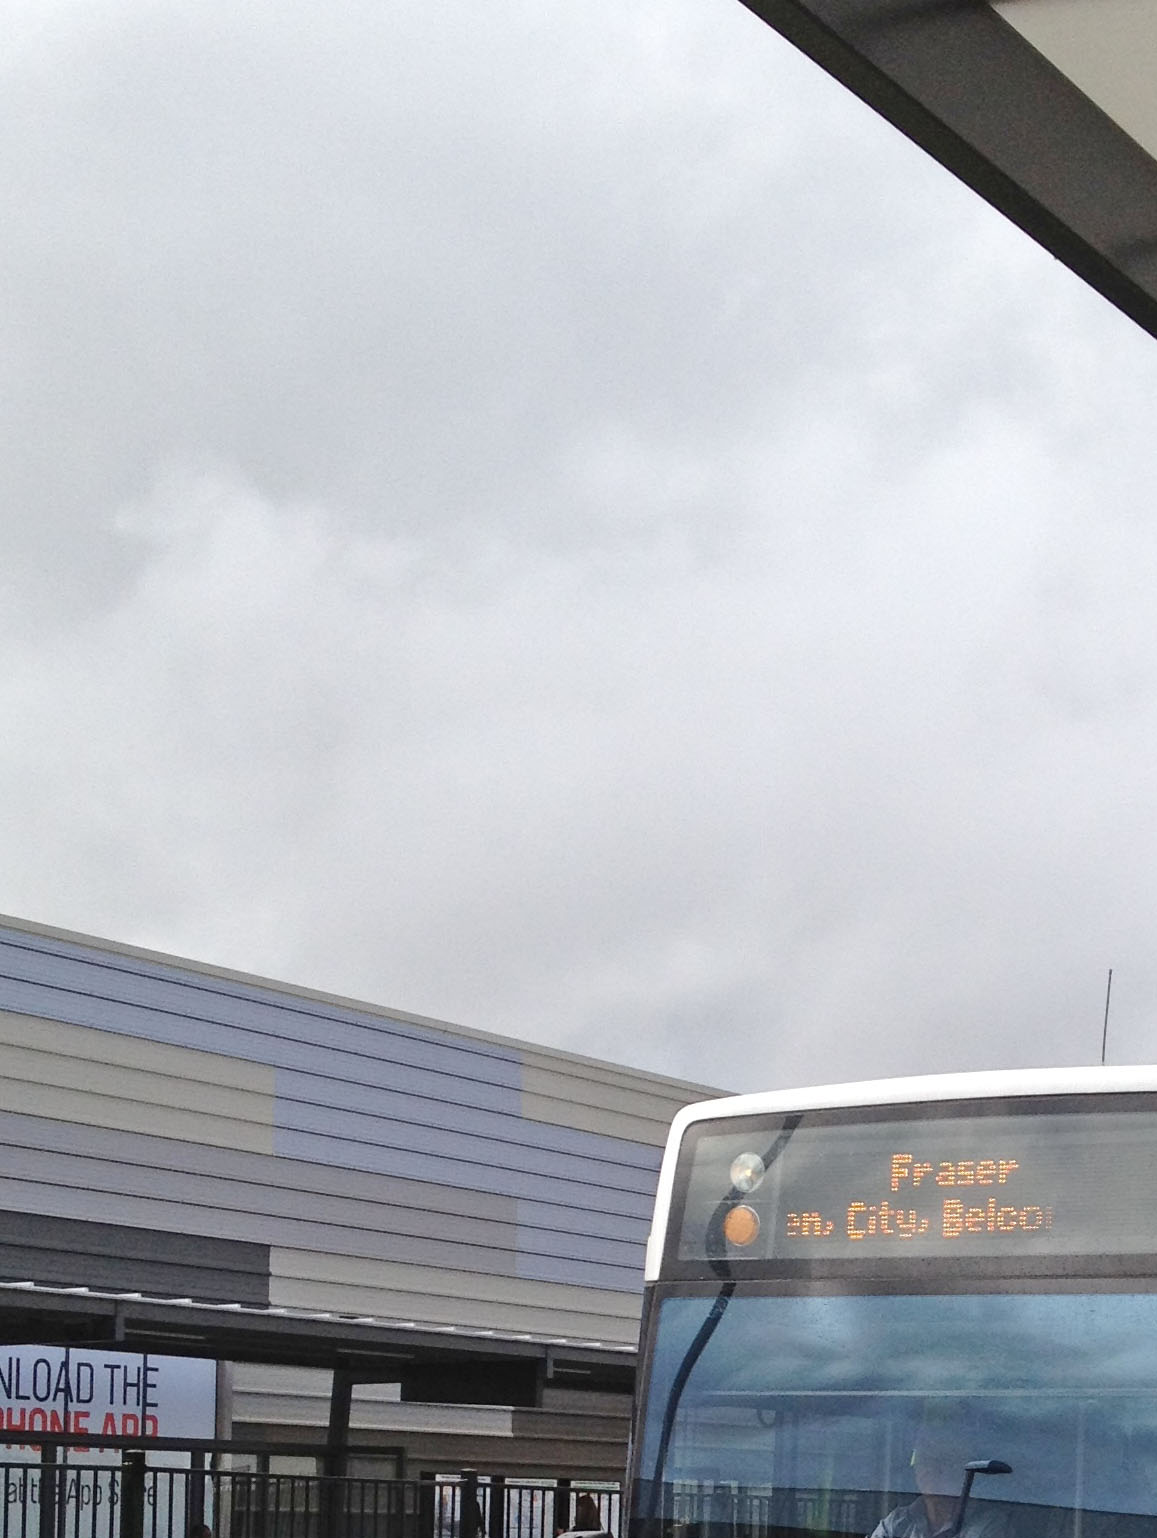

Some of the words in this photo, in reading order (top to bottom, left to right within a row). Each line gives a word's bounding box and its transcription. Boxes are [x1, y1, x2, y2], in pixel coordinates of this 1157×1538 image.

[890, 1153, 1020, 1191] Fraser
[847, 1200, 929, 1239] City,
[104, 1363, 159, 1408] THE
